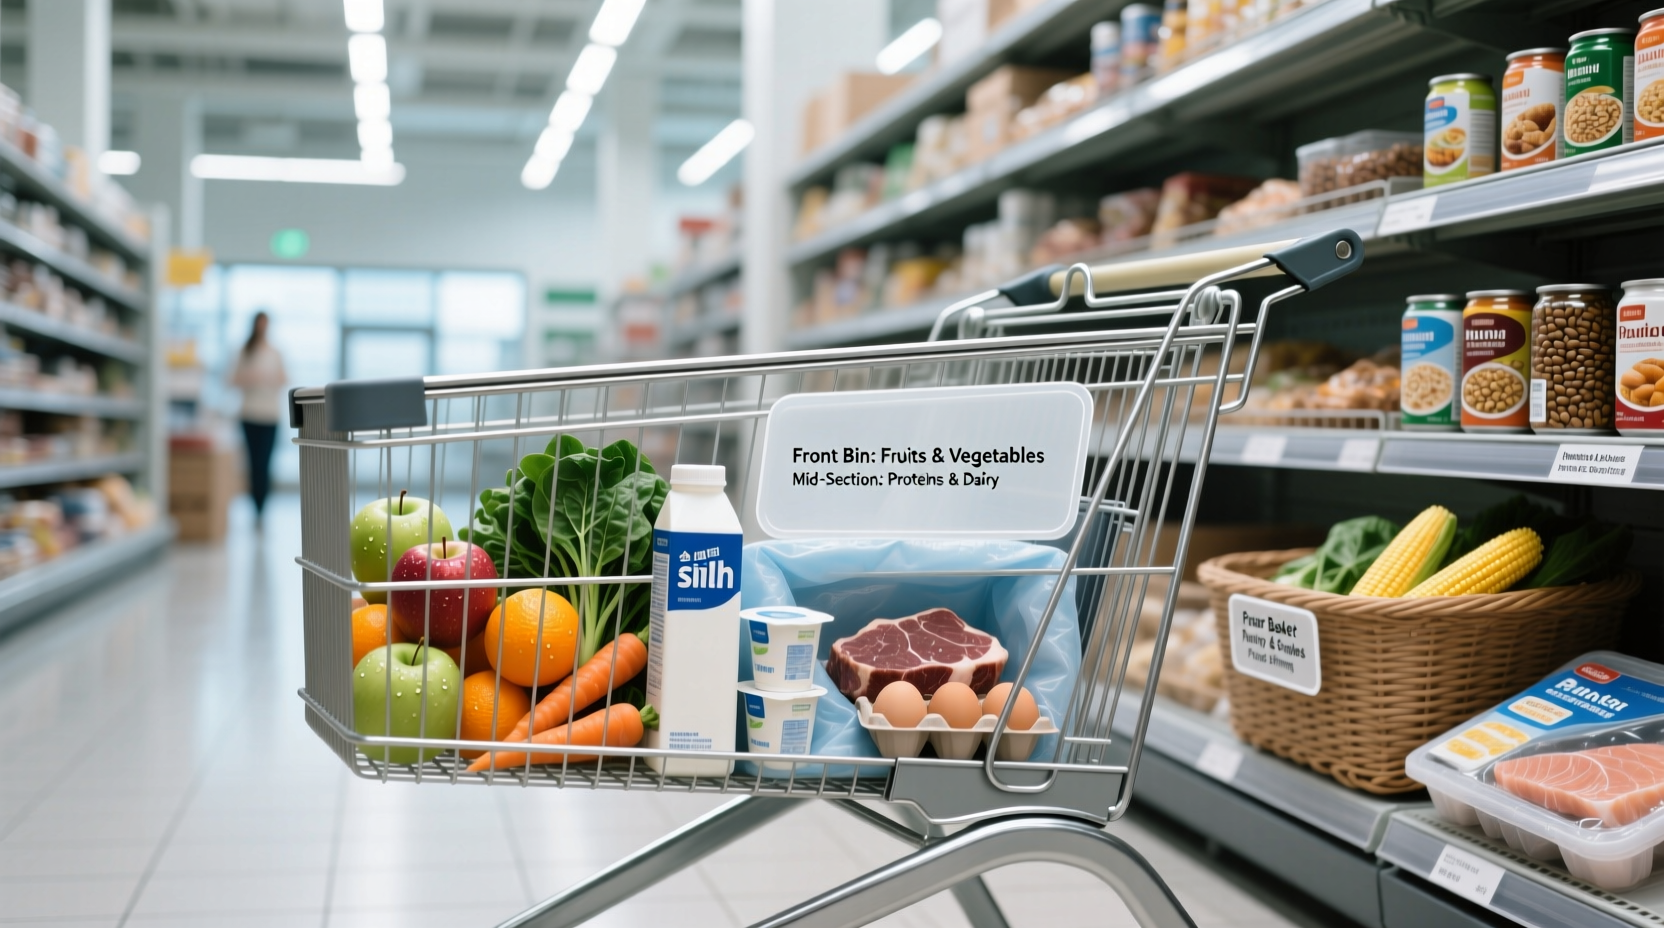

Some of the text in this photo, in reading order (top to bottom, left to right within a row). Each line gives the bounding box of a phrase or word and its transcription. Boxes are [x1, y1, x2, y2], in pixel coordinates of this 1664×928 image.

[793, 446, 1045, 468] Front Bin: Fruits & Vegetables
[793, 472, 883, 486] Mid-Section:
[949, 472, 959, 486] &
[963, 472, 999, 490] Dairy
